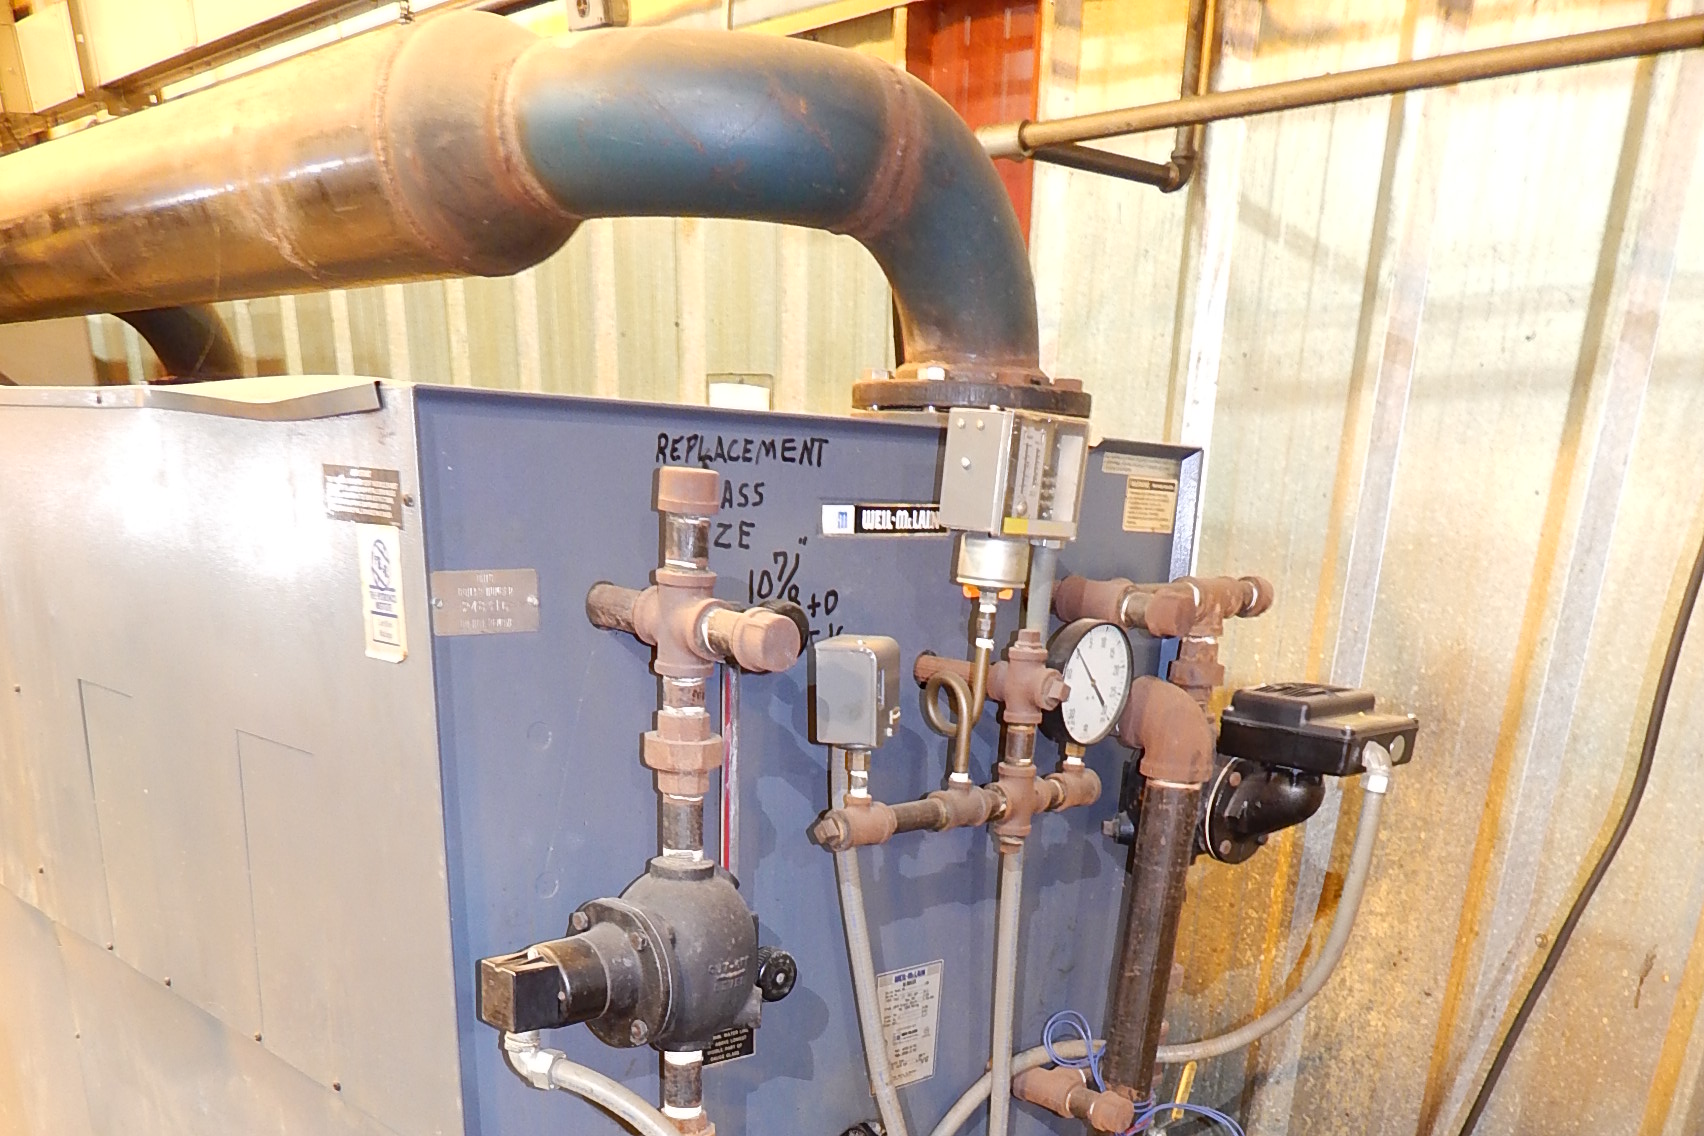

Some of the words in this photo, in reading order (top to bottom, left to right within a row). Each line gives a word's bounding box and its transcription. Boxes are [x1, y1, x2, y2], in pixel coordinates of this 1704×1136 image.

[655, 432, 829, 467] REPLACEMENT
[720, 480, 765, 509] ASS
[713, 520, 755, 550] ZE
